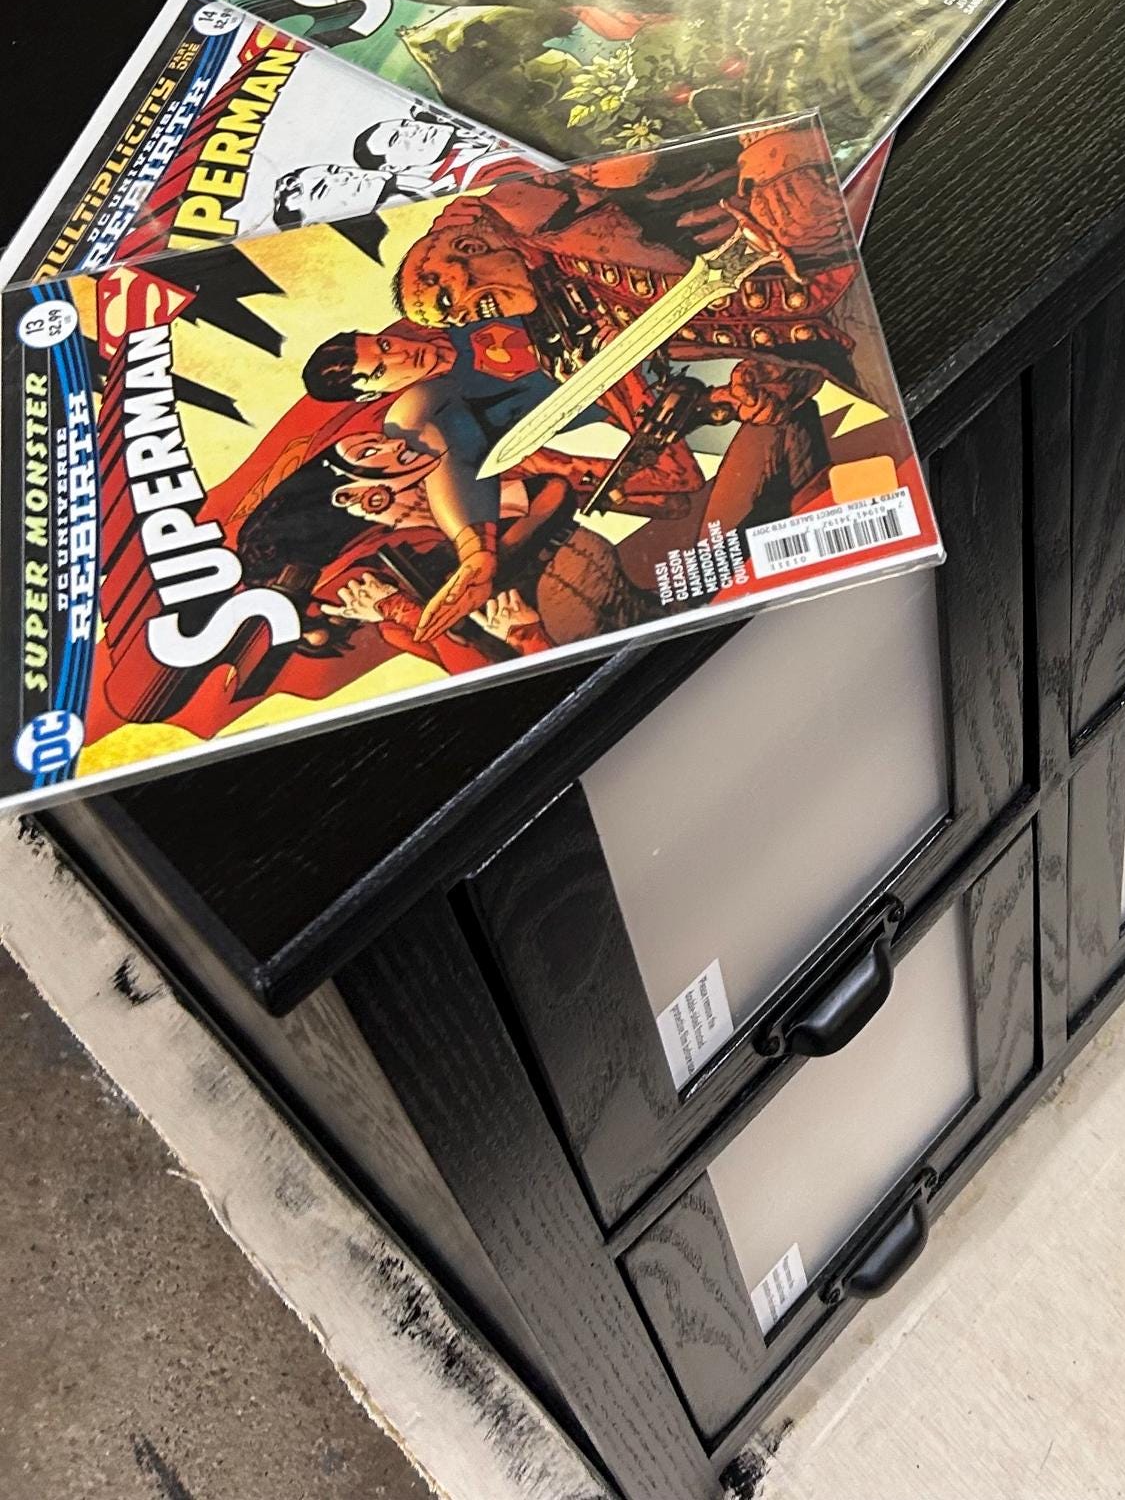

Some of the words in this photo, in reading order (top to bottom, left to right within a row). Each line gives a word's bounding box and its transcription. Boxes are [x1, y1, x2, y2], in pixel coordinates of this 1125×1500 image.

[198, 10, 216, 24] 14
[88, 214, 111, 242] DC
[110, 100, 180, 208] UNIVERSE
[25, 319, 45, 336] 13
[48, 308, 63, 338] $2.99
[25, 372, 49, 547] MONSTER
[56, 427, 69, 567] UNIVERSE
[68, 390, 97, 643] REBIRTH
[123, 324, 300, 668] SUPERMAN
[655, 563, 675, 606] TOMASI
[668, 549, 689, 602] GLEASON
[684, 548, 704, 597] MAHNKE
[726, 528, 750, 586] QUINTANA
[57, 573, 69, 611] DC
[24, 560, 49, 692] SUPER
[33, 713, 71, 773] DC
